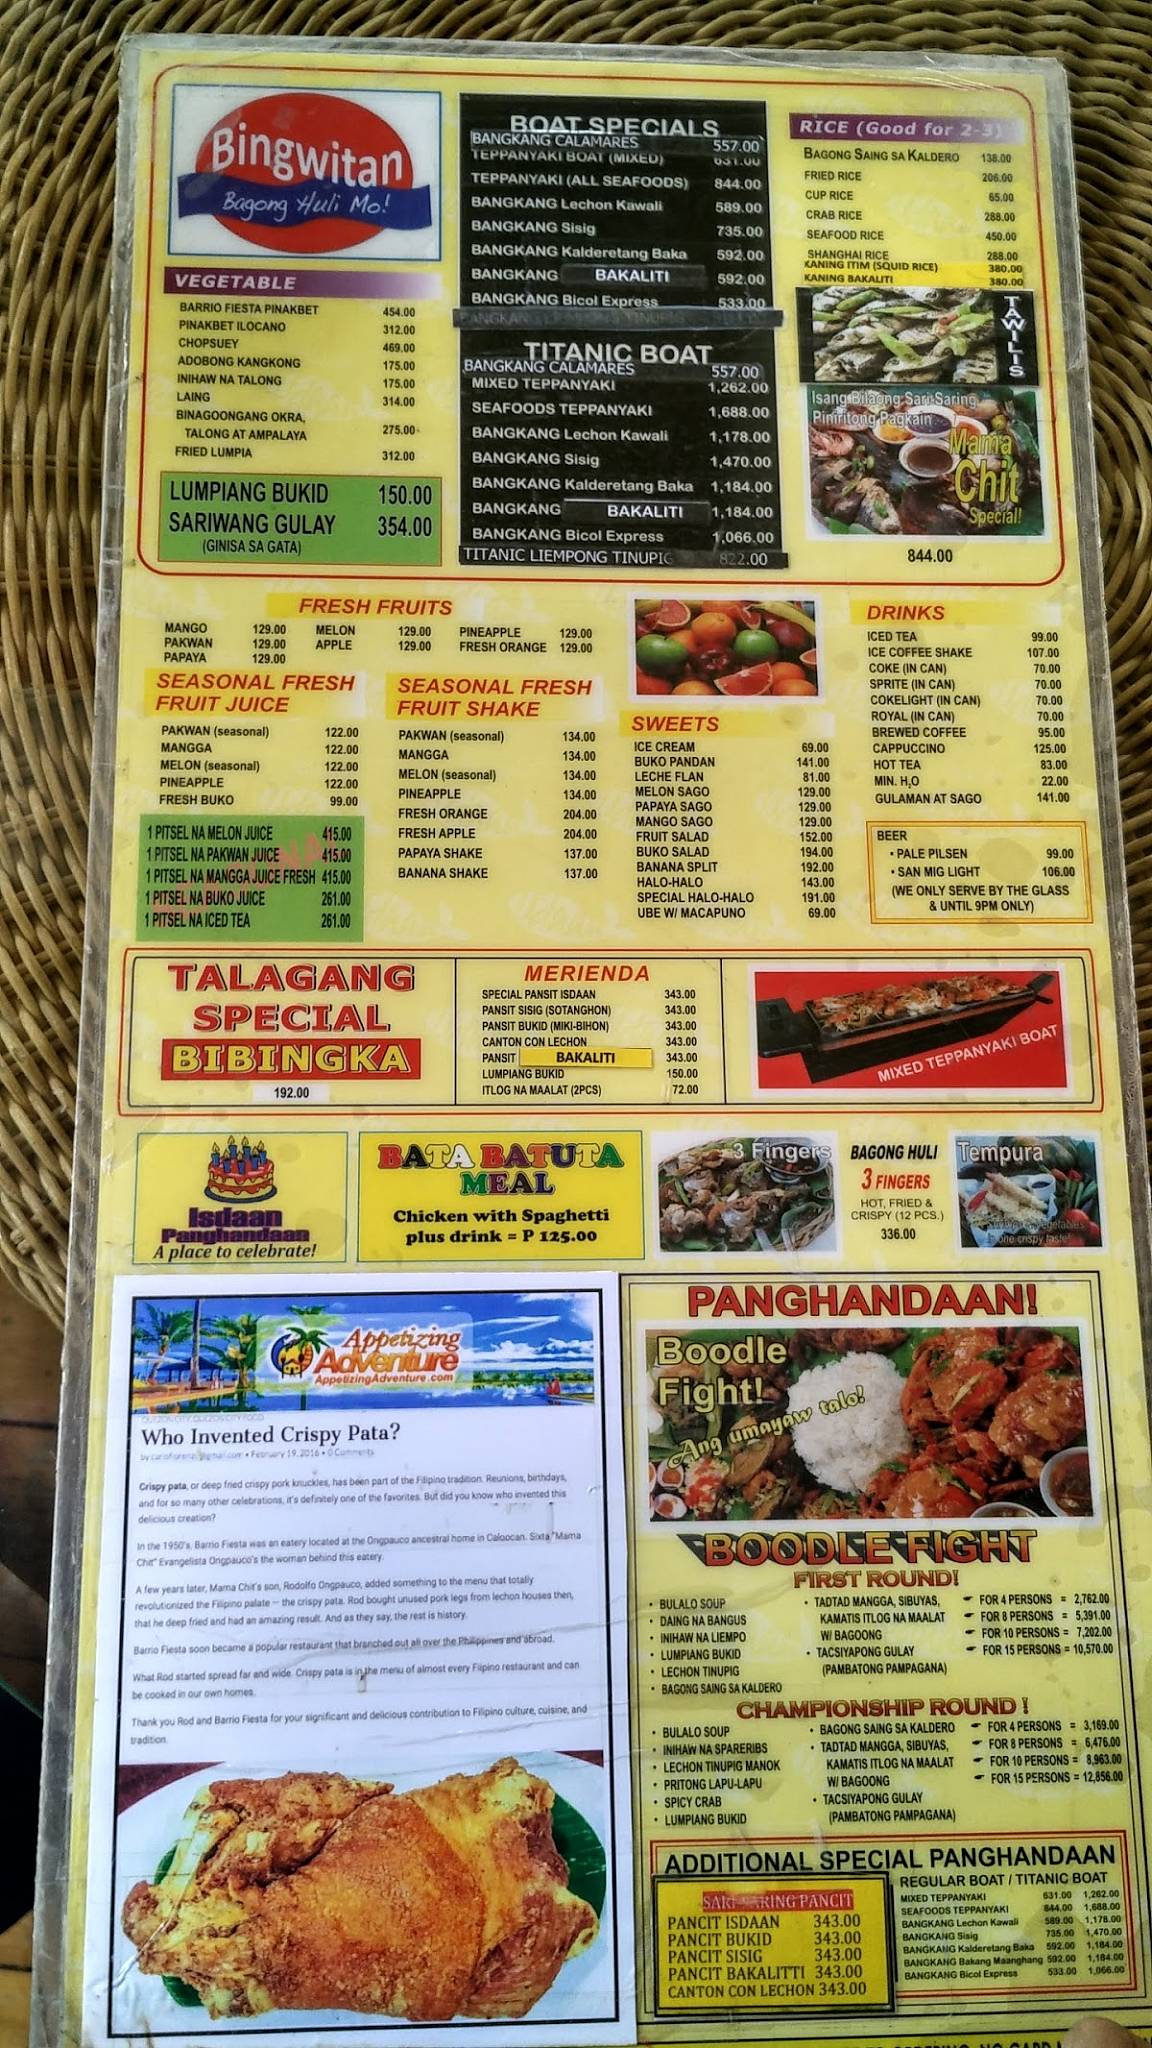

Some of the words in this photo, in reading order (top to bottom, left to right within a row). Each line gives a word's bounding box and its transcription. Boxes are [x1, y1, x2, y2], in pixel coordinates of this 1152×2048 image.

[511, 114, 582, 135] BOAT
[589, 117, 720, 138] SPECIALS
[800, 120, 848, 134] RICE
[857, 120, 918, 137] (Good
[924, 122, 954, 136] for
[472, 134, 550, 146] BANGKANG
[554, 135, 638, 149] CALAMARES
[712, 139, 759, 153] 557.00
[211, 122, 403, 188] Bingwitan
[471, 173, 563, 185] TEPPANYAKI
[566, 175, 600, 187] (ALL
[603, 176, 688, 190] SEAFOODS)
[714, 178, 761, 191] 844.00
[804, 170, 834, 181] FRIED
[837, 171, 862, 181] RICE
[982, 173, 1013, 183] 206.00
[222, 189, 287, 221] Bagong
[296, 193, 340, 215] Huli
[349, 194, 390, 214] Mo!
[471, 244, 557, 257] BANGKANG
[562, 246, 648, 261] Kalderetang
[651, 247, 687, 260] Baka
[716, 248, 764, 262] 592.00
[174, 274, 297, 291] VEGETABLE
[180, 302, 222, 313] BARRIO
[225, 302, 263, 315] FIESTA
[265, 304, 319, 316] PINAKBET
[382, 307, 415, 318] 454.00
[1001, 296, 1027, 378] TAWILIS
[524, 342, 632, 363] TITANIC
[640, 344, 712, 365] BOAT
[950, 428, 1012, 455] Mama
[955, 458, 1020, 502] Chit
[170, 481, 266, 503] LUMPIANG
[272, 483, 328, 504] BUKID
[378, 484, 432, 505] 150.00
[472, 502, 561, 516] BANGKANG
[607, 505, 683, 519] BAKALITI
[711, 505, 773, 520] 1,184.00
[969, 507, 1022, 526] Special!
[168, 512, 269, 534] SARIWANG
[276, 514, 336, 535] GULAY
[377, 516, 432, 537] 354.00
[202, 538, 246, 554] (GINISA
[249, 540, 264, 553] SA
[267, 540, 301, 555] GATA)
[907, 549, 953, 564] 844.00
[299, 598, 370, 614] FRESH
[377, 599, 453, 616] FRUITS
[866, 605, 945, 621] DRINKS
[164, 622, 207, 634] MANGO
[253, 624, 286, 636] 129.00
[316, 625, 355, 636] MELON
[398, 626, 431, 637] 129.00
[460, 626, 521, 638] PINEAPPLE
[559, 627, 592, 639] 129.00
[156, 674, 274, 691] SEASONAL
[282, 675, 355, 692] FRESH
[398, 678, 514, 694] SEASONAL
[521, 679, 592, 696] FRESH
[156, 696, 220, 712] FRUIT
[226, 697, 290, 713] JUICE
[397, 700, 462, 716] FRUIT
[467, 701, 540, 717] SHAKE
[631, 716, 720, 733] SWEETS
[876, 830, 907, 841] BEER
[898, 866, 921, 877] SAN
[924, 866, 945, 878] MIG
[948, 867, 980, 878] LIGHT
[1042, 867, 1075, 878] 106.00
[637, 877, 703, 888] HALO-HALO
[800, 877, 834, 888] 143.00
[152, 913, 184, 928] PITSEL
[186, 913, 202, 928] NA
[205, 913, 227, 928] ICED
[230, 913, 251, 928] TEA
[321, 914, 351, 928] 261.00
[167, 964, 415, 992] TALAGANG
[524, 965, 651, 982] MERIENDA
[192, 1004, 390, 1032] SPECIAL
[171, 1044, 410, 1073] BIBINGKA
[482, 1052, 516, 1063] PANSIT
[556, 1052, 615, 1063] BAKALITI
[666, 1052, 698, 1063] 343.00
[877, 1061, 924, 1083] MIXED
[926, 1036, 1017, 1070] TEPPANYAKI
[1019, 1024, 1058, 1045] BOAT
[273, 1087, 310, 1100] 192.00
[378, 1144, 476, 1169] BATA
[481, 1144, 625, 1169] BATUTA
[732, 1142, 744, 1159] 3
[752, 1142, 832, 1162] Fingers
[850, 1145, 904, 1160] BAGONG
[907, 1145, 938, 1160] HULI
[958, 1142, 1044, 1165] Tempura
[460, 1171, 556, 1195] MEAL
[861, 1168, 872, 1190] 3
[875, 1174, 931, 1189] FINGERS
[188, 1207, 283, 1228] Isdaan
[393, 1209, 468, 1223] Chicken
[474, 1208, 518, 1223] with
[522, 1207, 610, 1226] Spaghetti
[161, 1226, 310, 1245] Panghandaan
[406, 1229, 445, 1246] plus
[449, 1229, 502, 1243] drink
[540, 1229, 597, 1244] 125.00
[881, 1228, 916, 1240] 336.00
[153, 1246, 162, 1258] A
[166, 1245, 212, 1261] place
[216, 1246, 232, 1258] to
[236, 1244, 316, 1259] celebrate!
[688, 1283, 1038, 1317] PANGHANDAAN!
[342, 1327, 461, 1352] Appetizing
[657, 1336, 787, 1365] Boodle
[314, 1347, 459, 1375] Adventure
[658, 1377, 763, 1412] Fight!
[141, 1428, 184, 1447] Who
[191, 1426, 274, 1445] Invented
[281, 1425, 341, 1445] Crispy
[347, 1423, 401, 1442] Pata?
[668, 1436, 722, 1468] Ang
[728, 1407, 813, 1445] umayaw
[818, 1385, 865, 1417] talo!
[138, 1513, 175, 1523] delicious
[177, 1512, 216, 1523] creation?
[704, 1531, 892, 1566] BOODLE
[906, 1530, 1037, 1563] FIGHT
[793, 1571, 861, 1589] FIRST
[867, 1569, 959, 1588] ROUND!
[736, 1700, 924, 1719] CHAMPIONSHIP
[929, 1698, 1017, 1716] ROUND
[662, 1727, 701, 1738] BULALO
[704, 1726, 730, 1738] SOUP
[665, 1850, 814, 1875] ADDITIONAL
[819, 1849, 922, 1870] SPECIAL
[930, 1844, 1116, 1868] PANGHANDAAN
[901, 1893, 926, 1902] MIXED
[928, 1892, 986, 1902] TEPPANYAKI
[667, 1915, 721, 1930] PANCIT
[725, 1914, 780, 1930] ISDAAN
[813, 1913, 861, 1928] 343.00
